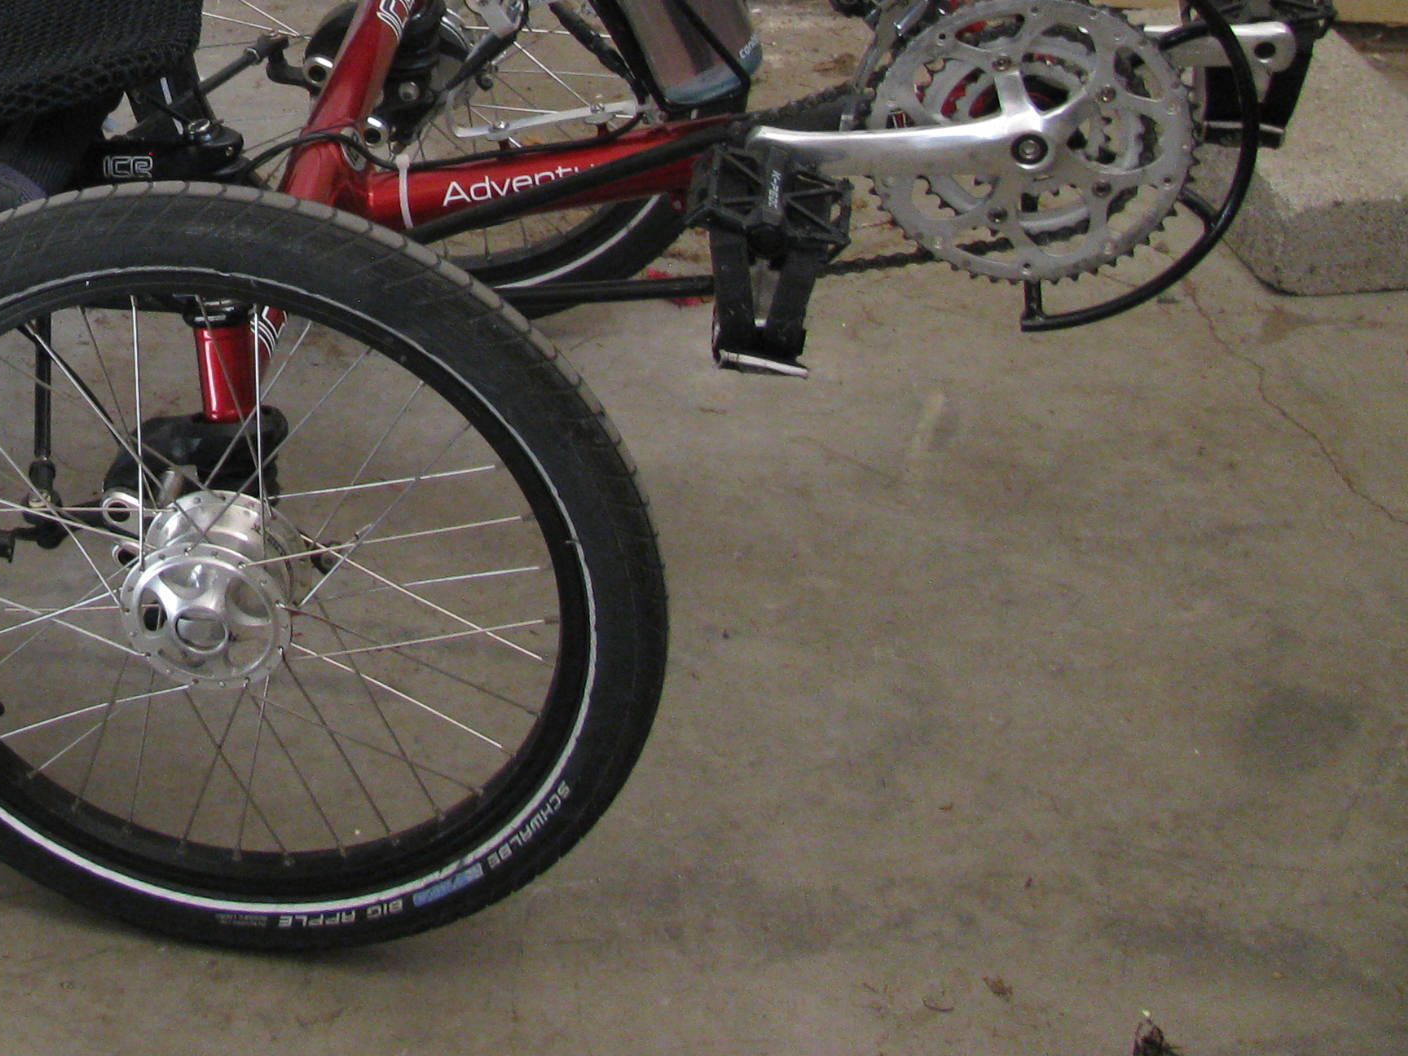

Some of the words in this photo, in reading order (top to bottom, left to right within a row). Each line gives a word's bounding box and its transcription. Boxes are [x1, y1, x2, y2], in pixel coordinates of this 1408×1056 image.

[103, 155, 153, 178] ICE
[486, 779, 571, 871] SCHWALBE
[278, 908, 356, 929] APPLE
[366, 898, 404, 919] BIG
